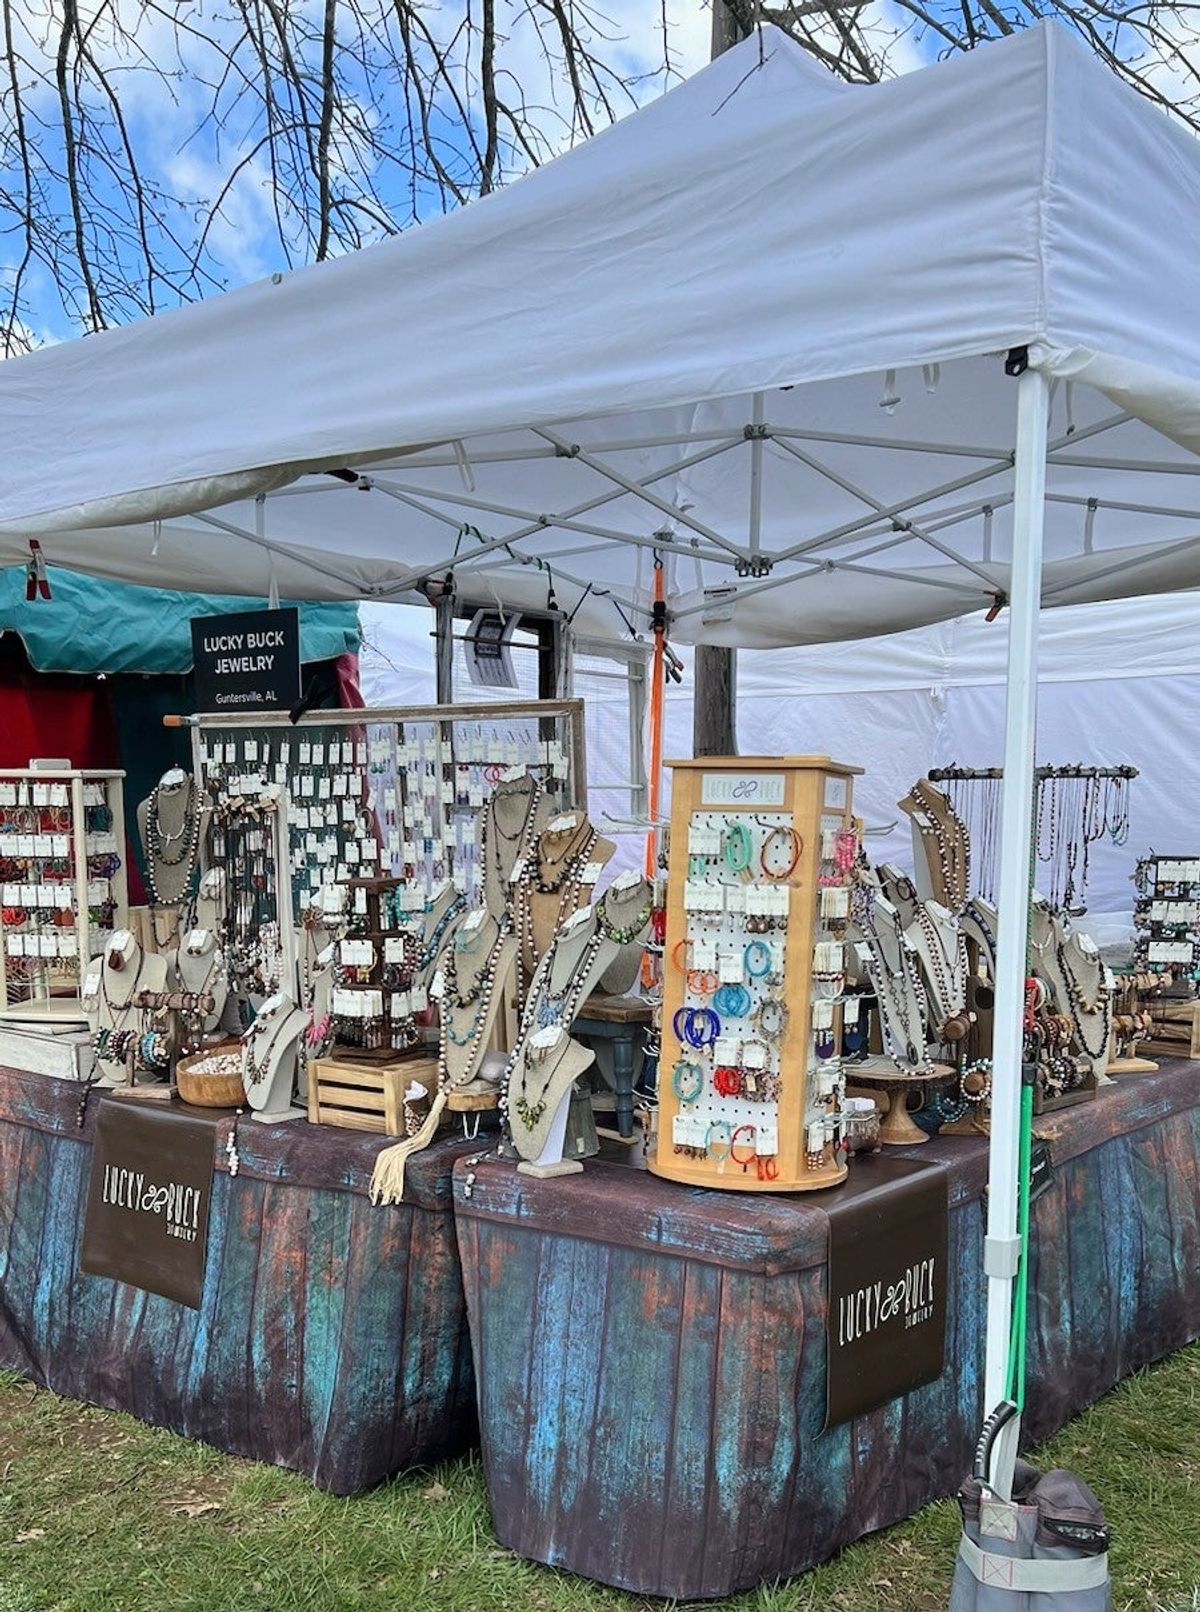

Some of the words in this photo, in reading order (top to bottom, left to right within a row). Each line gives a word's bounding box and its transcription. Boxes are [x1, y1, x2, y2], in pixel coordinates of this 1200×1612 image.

[204, 634, 244, 652] LUCKY
[247, 631, 284, 648] BUCK
[215, 655, 274, 674] JEWELRY
[265, 690, 278, 701] AL
[103, 1164, 144, 1211] LUCKY
[166, 1182, 201, 1229] BUCK
[840, 1281, 881, 1346] LUCKY
[905, 1257, 935, 1314] BUCK
